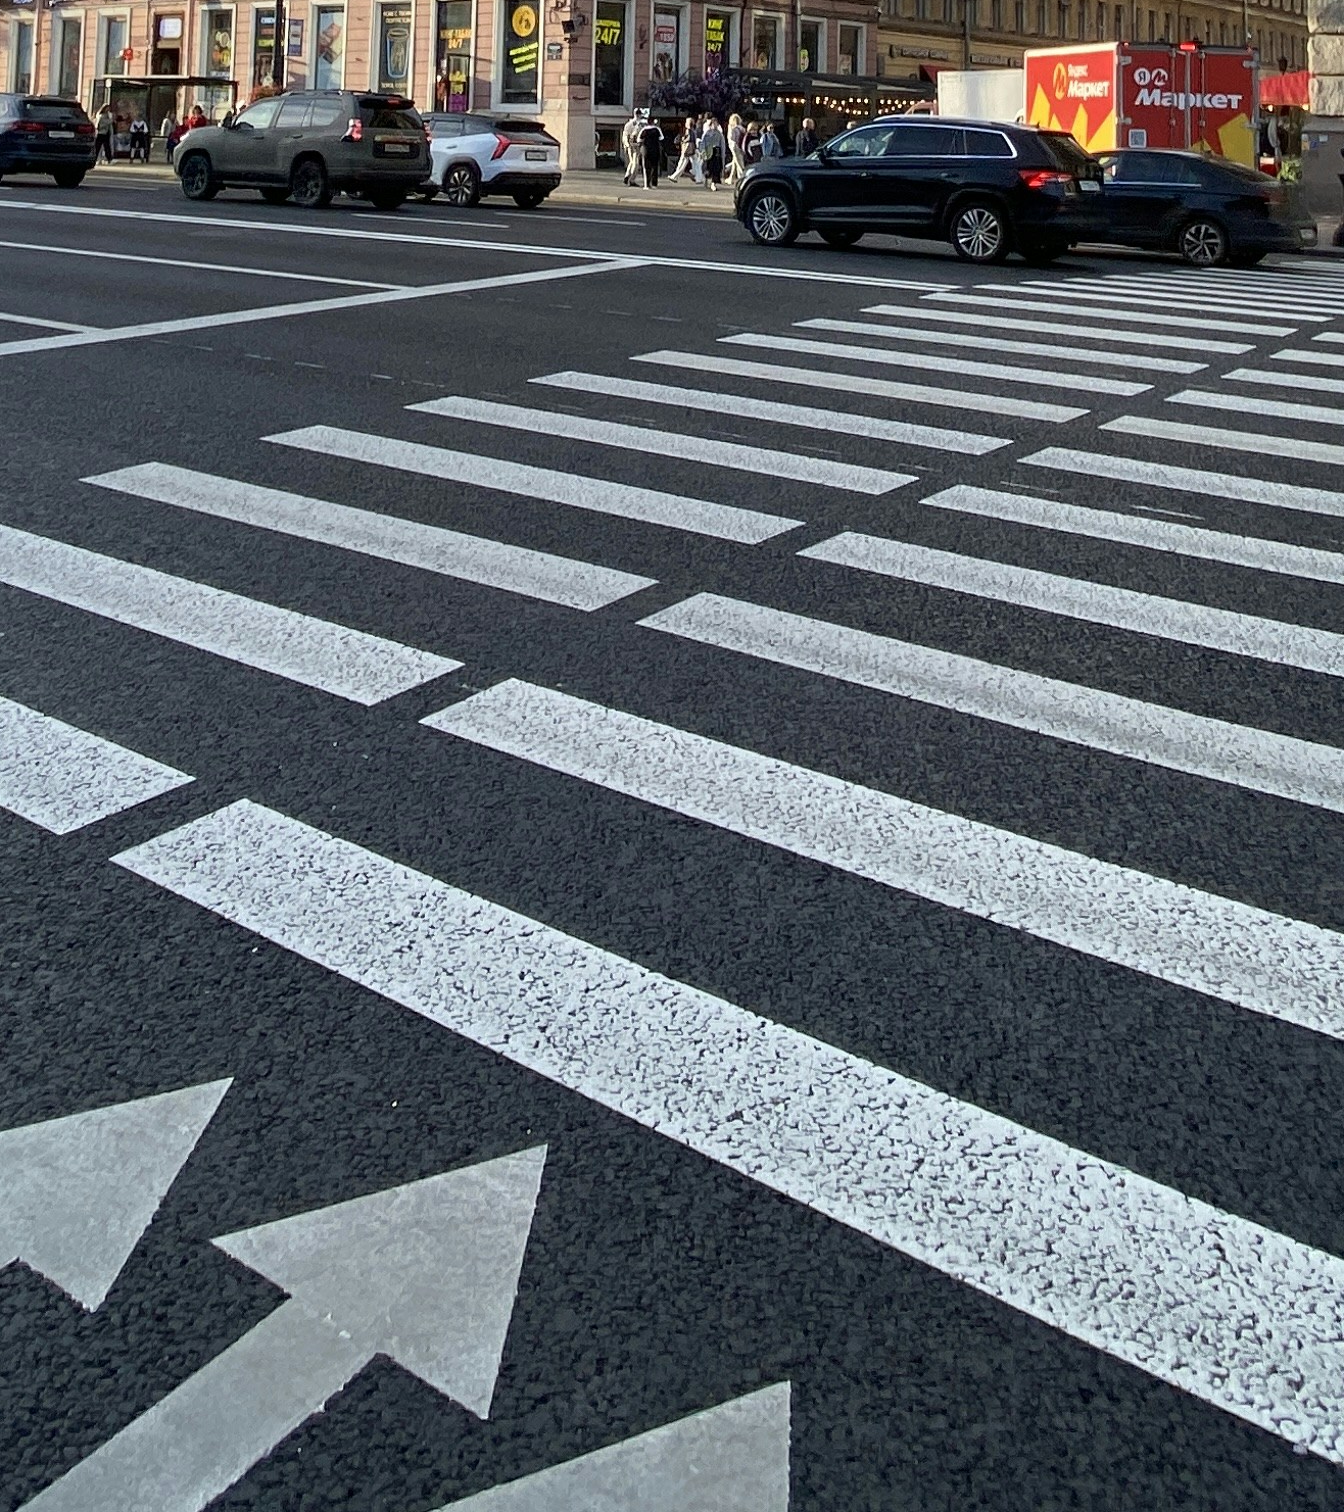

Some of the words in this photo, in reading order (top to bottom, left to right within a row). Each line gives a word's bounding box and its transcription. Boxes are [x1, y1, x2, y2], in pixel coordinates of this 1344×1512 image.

[594, 27, 621, 45] 24/7
[1067, 81, 1110, 101] Маркет
[1135, 88, 1242, 110] Маркет
